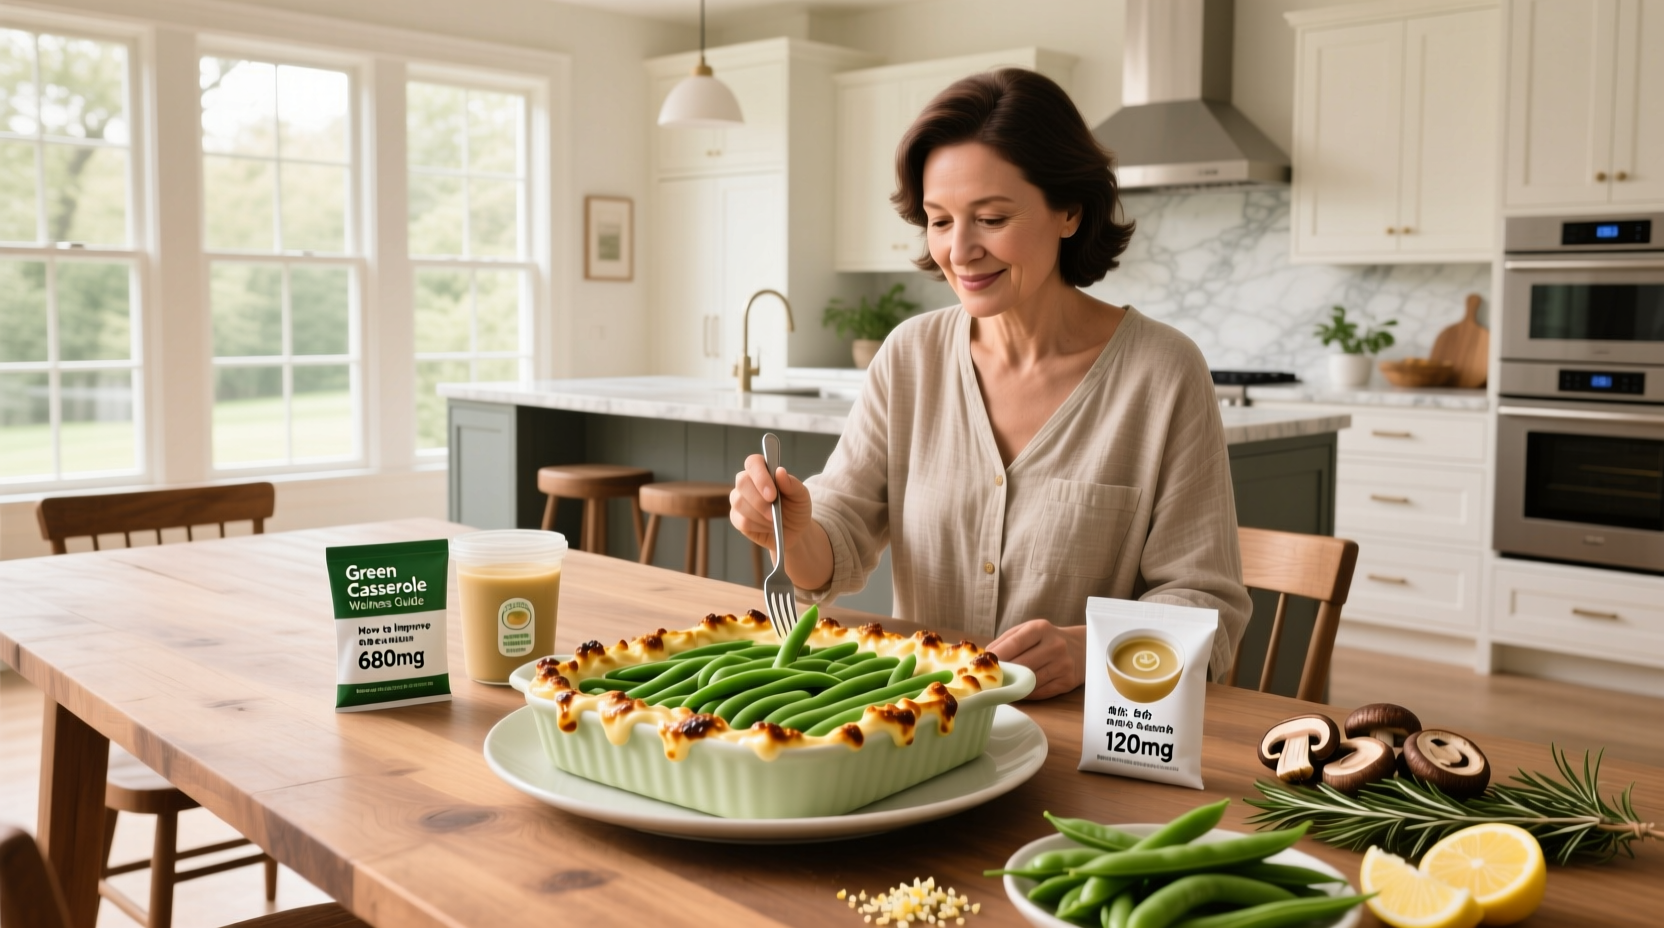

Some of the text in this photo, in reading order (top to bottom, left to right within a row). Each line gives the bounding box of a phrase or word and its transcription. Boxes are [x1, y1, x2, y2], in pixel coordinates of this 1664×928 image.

[345, 564, 397, 581] Green
[347, 576, 427, 597] Casserole
[358, 649, 425, 670] 680mg
[1106, 731, 1174, 764] 120mg
